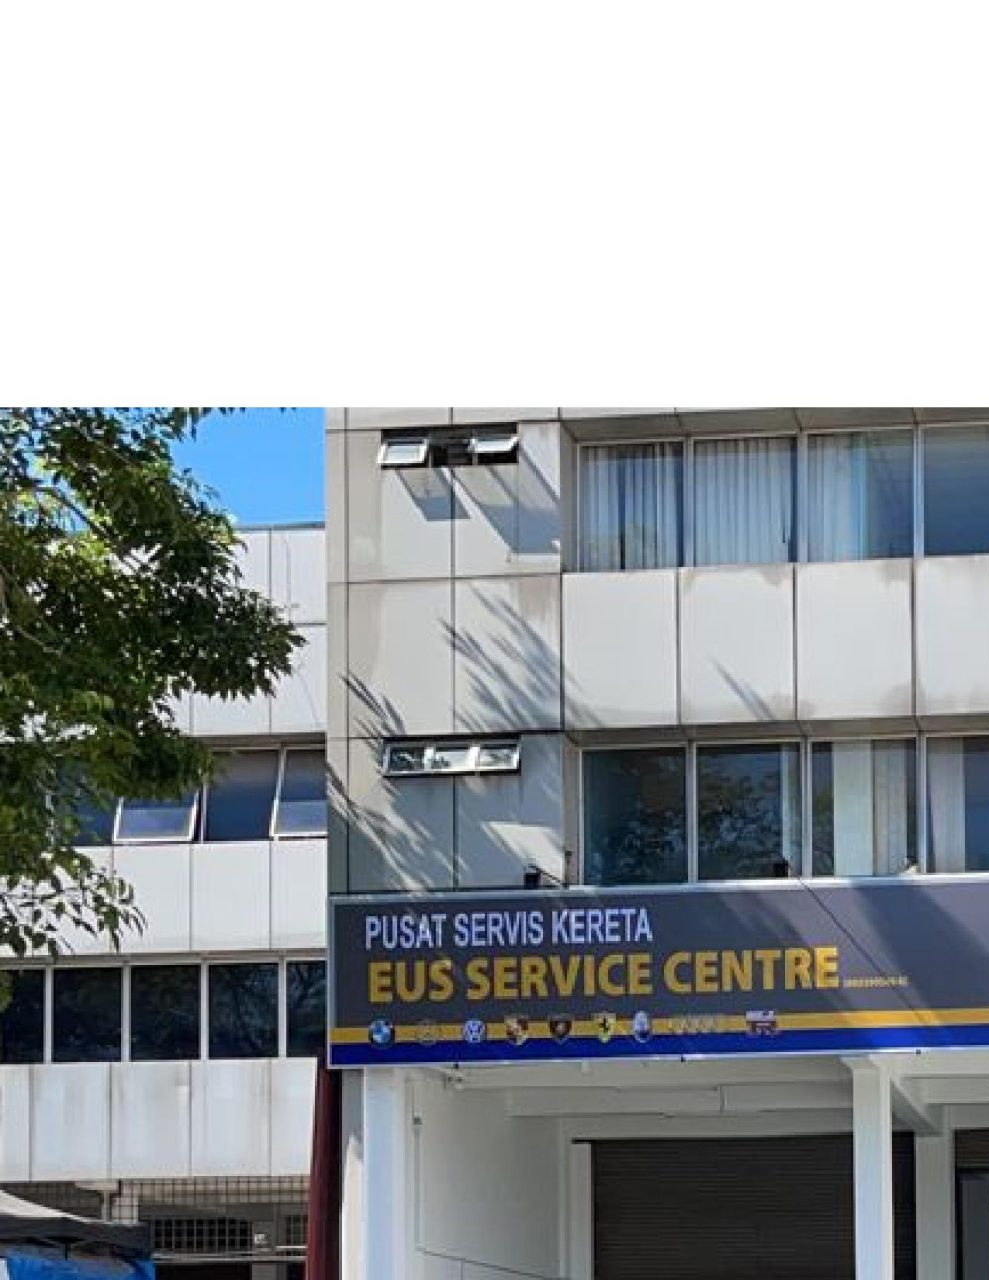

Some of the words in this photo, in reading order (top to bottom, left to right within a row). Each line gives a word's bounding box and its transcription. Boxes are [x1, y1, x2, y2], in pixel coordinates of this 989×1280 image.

[365, 913, 446, 950] PUSAT
[453, 910, 544, 947] SERVIS
[551, 907, 653, 944] KERETA
[368, 960, 454, 1003] EUS
[466, 954, 653, 1000] SERVICE
[663, 947, 839, 993] CENTRE
